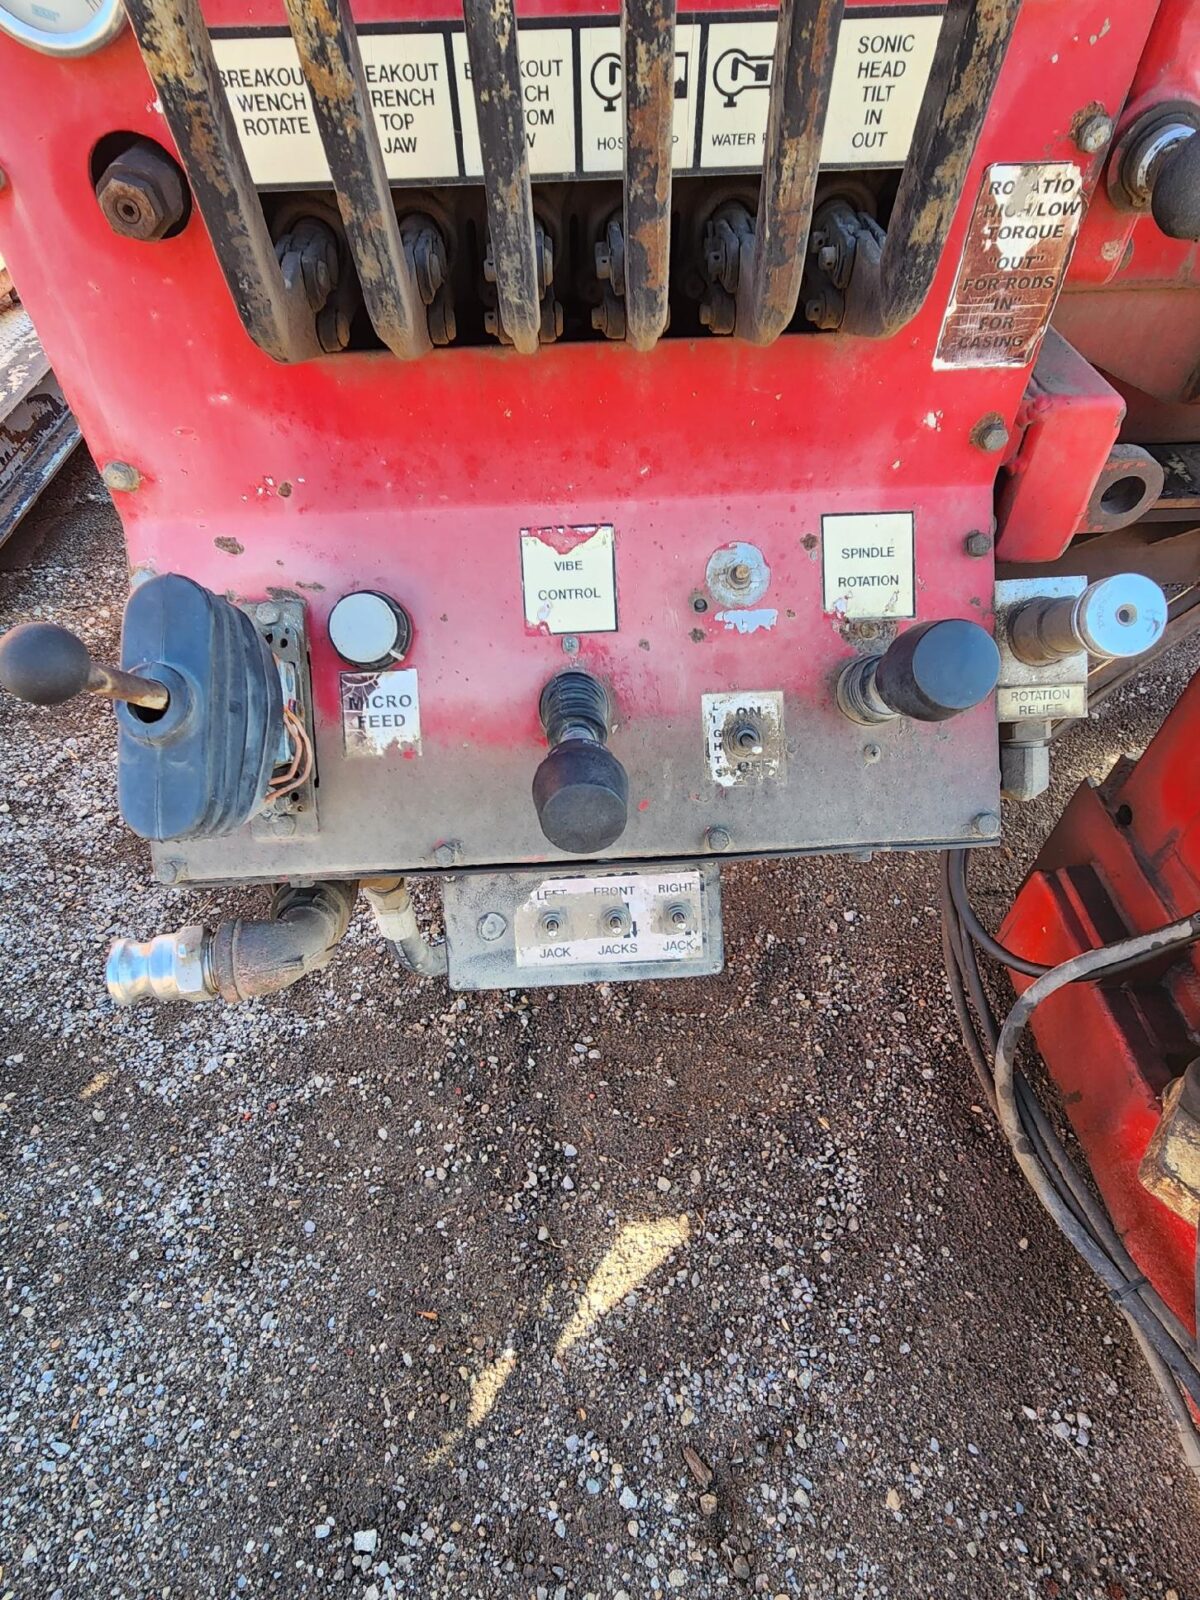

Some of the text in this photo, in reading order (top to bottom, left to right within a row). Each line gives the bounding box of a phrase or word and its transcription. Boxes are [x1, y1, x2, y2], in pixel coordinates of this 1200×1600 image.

[857, 34, 916, 54] SONIC
[219, 67, 305, 88] BREAKOU
[364, 62, 439, 83] EAKOUT
[857, 60, 907, 79] HEAD
[370, 88, 435, 108] RENCH
[862, 85, 896, 102] TILT
[236, 92, 307, 113] WENCH
[379, 113, 415, 131] TOP
[864, 108, 883, 126] IN
[243, 116, 311, 136] ROTATE
[383, 136, 418, 154] JAW
[597, 136, 625, 151] HOS
[711, 133, 756, 147] WATER
[851, 131, 888, 149] OUT
[987, 224, 1065, 241] TORQUE
[962, 275, 1055, 292] FOR RODS
[978, 316, 1014, 331] FOR
[958, 335, 1025, 350] CASING
[840, 546, 895, 559] SPINDLE
[553, 559, 583, 572] VIBE
[837, 574, 900, 588] ROTATION
[537, 587, 602, 601] CONTROL
[348, 694, 412, 711] MICRO
[1010, 688, 1071, 701] ROTATION
[736, 706, 762, 718] ON
[358, 714, 406, 729] FEED
[658, 882, 694, 894] RIGHT
[539, 940, 694, 959] JACK JACKS JACK
